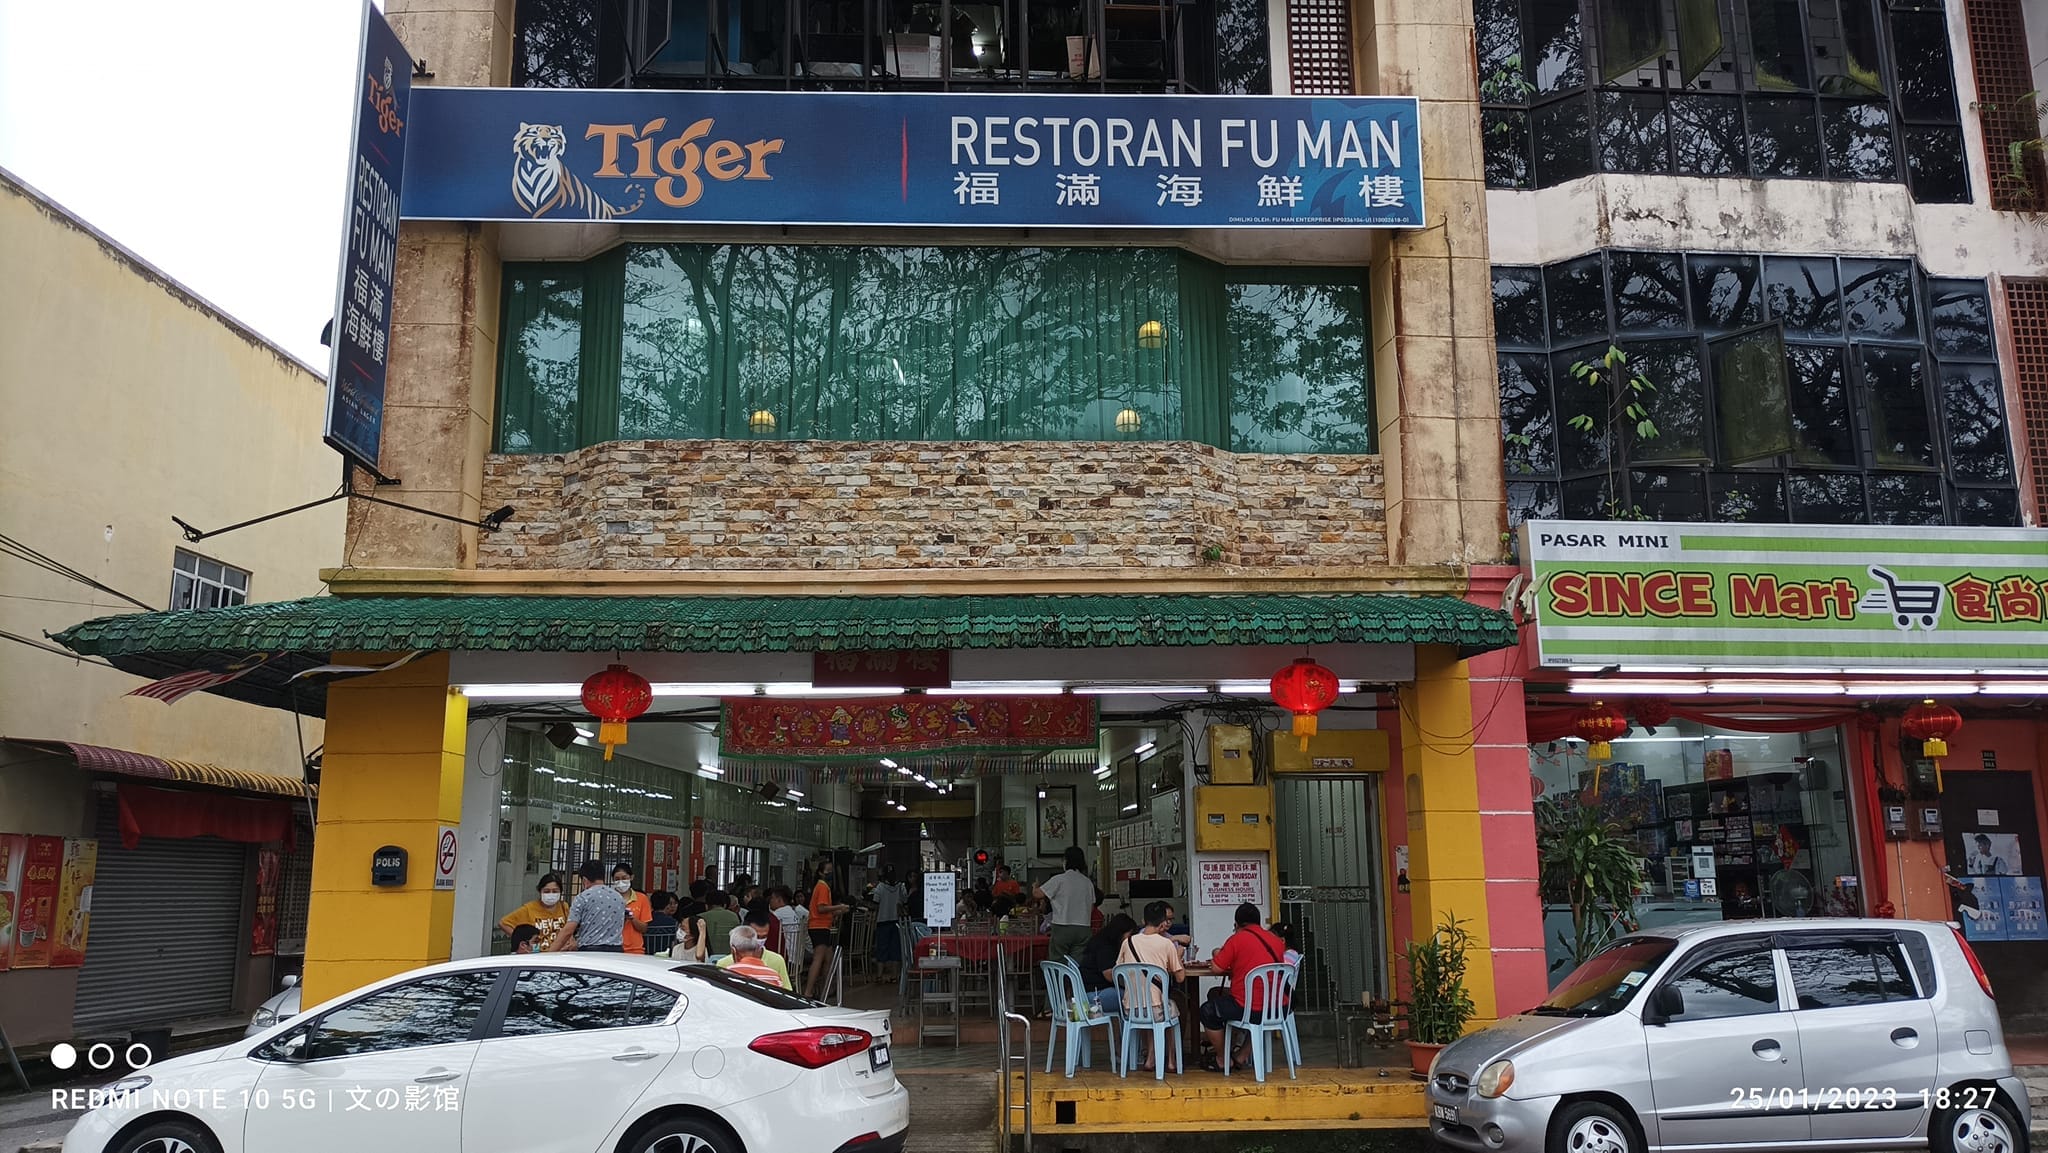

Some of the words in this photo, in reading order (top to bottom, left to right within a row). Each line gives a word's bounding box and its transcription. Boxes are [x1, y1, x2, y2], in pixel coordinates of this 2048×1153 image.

[368, 72, 404, 137] Tiger
[584, 117, 785, 208] Tiger
[951, 115, 1202, 168] RESTORAN
[1220, 119, 1279, 168] FU
[1297, 119, 1402, 168] MAN
[357, 154, 399, 239] RESTORAN
[953, 171, 1406, 208] 福滿海鮮樓
[352, 205, 370, 260] FU
[369, 222, 395, 286] MAN
[353, 265, 385, 322] 福滿
[344, 301, 385, 366] 海鮮樓
[1540, 534, 1607, 548] PASAR
[1618, 535, 1669, 548] MINI
[1550, 570, 1717, 618] SINCE
[1728, 573, 1858, 620] Mart
[1945, 573, 2048, 623] 食尚
[376, 858, 401, 868] POLIS
[1232, 872, 1258, 880] THURSDAY
